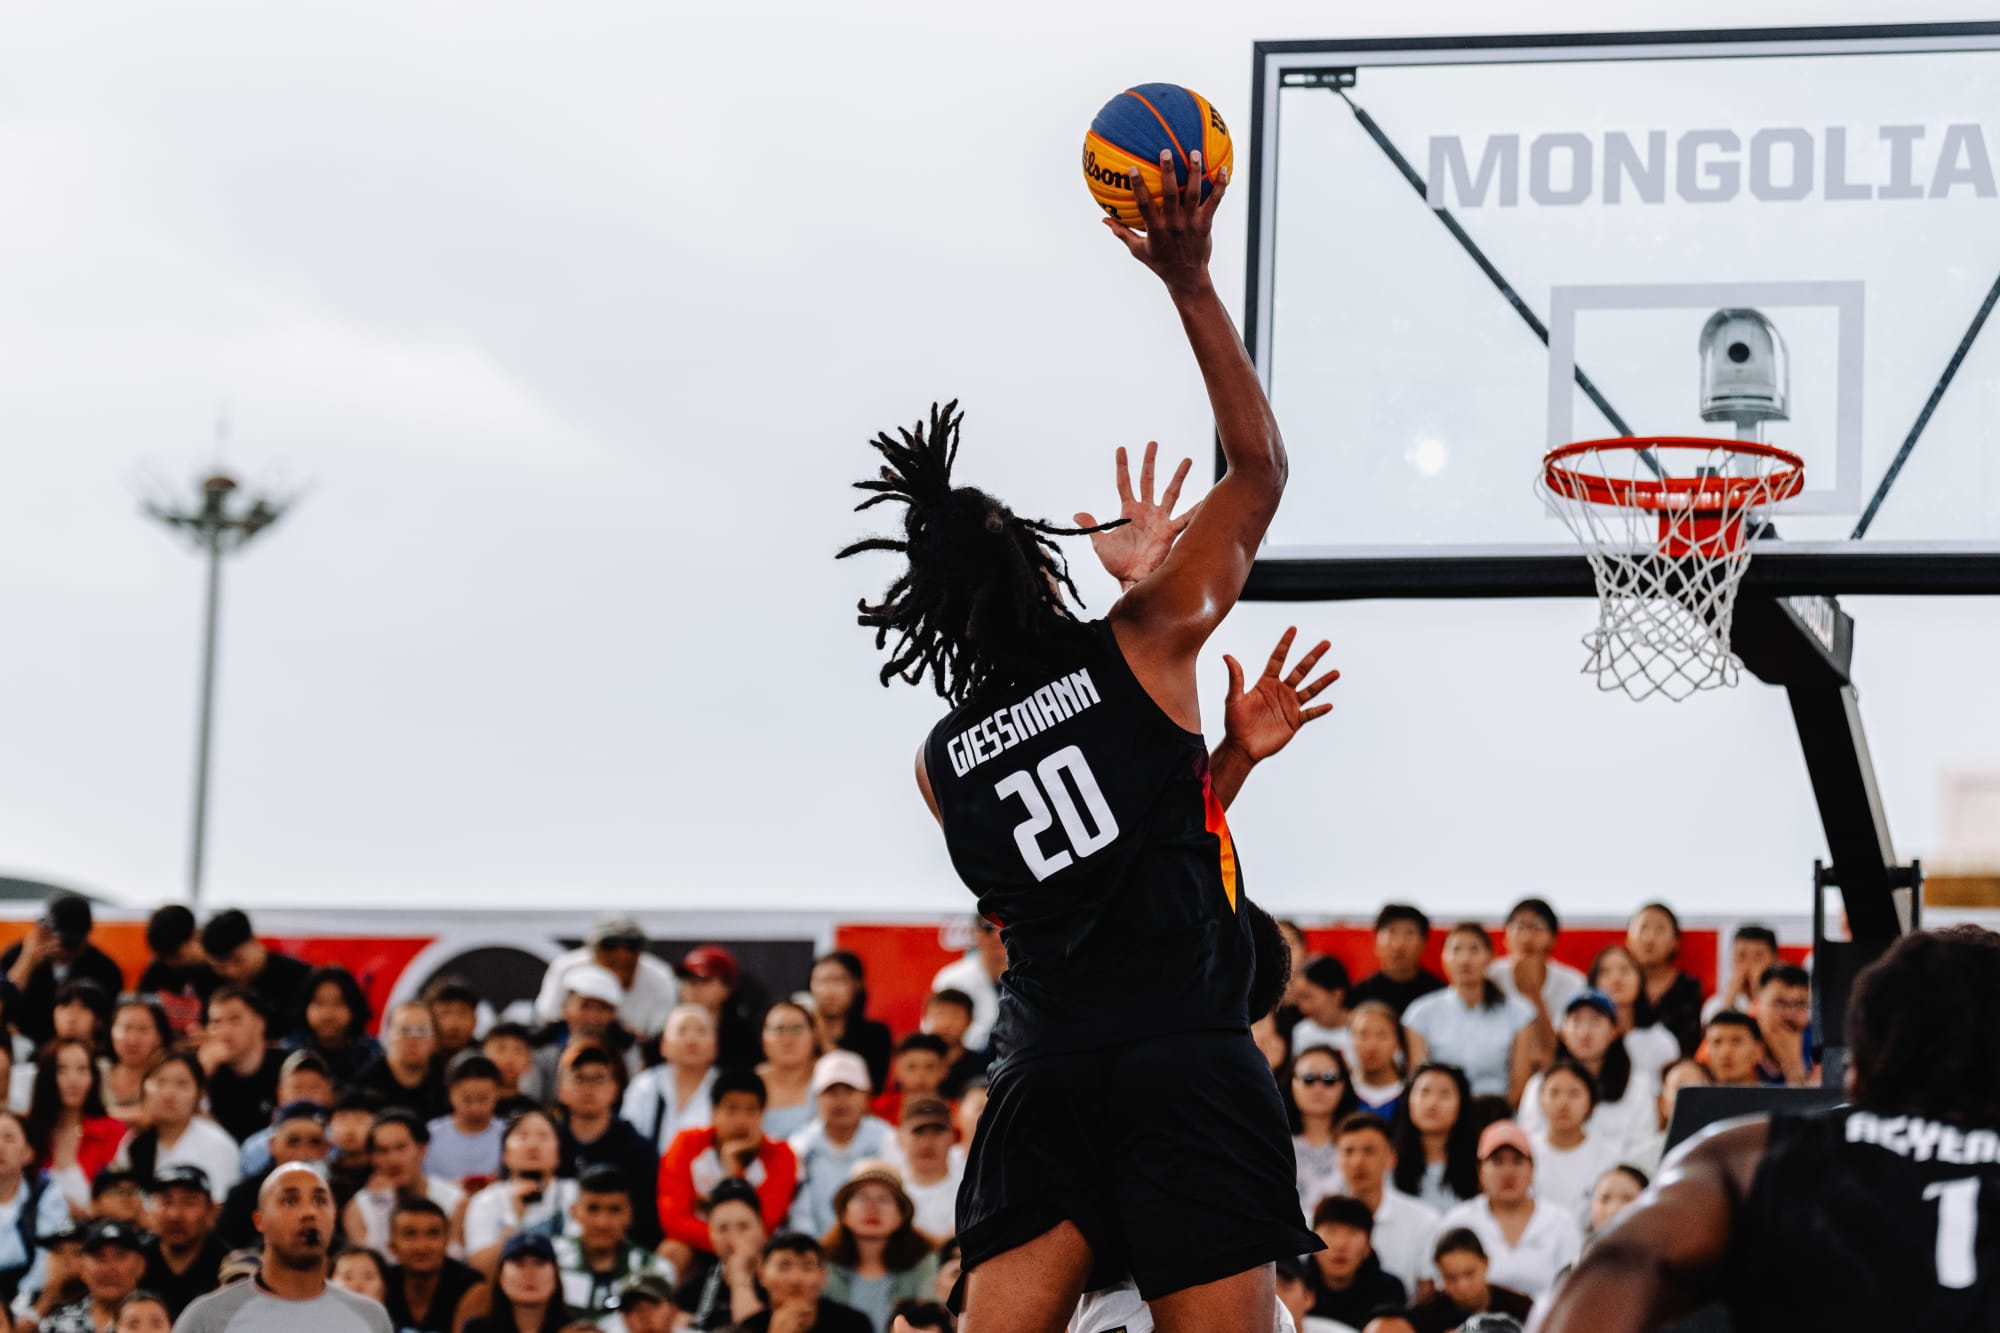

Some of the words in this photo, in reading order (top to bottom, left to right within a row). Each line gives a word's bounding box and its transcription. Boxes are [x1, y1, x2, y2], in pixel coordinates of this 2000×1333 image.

[1083, 143, 1133, 191] ilson
[1427, 123, 1999, 208] MONGOLIA
[947, 667, 1102, 778] GIESSMANN
[994, 745, 1120, 882] 20
[1922, 1177, 1980, 1289] 1
